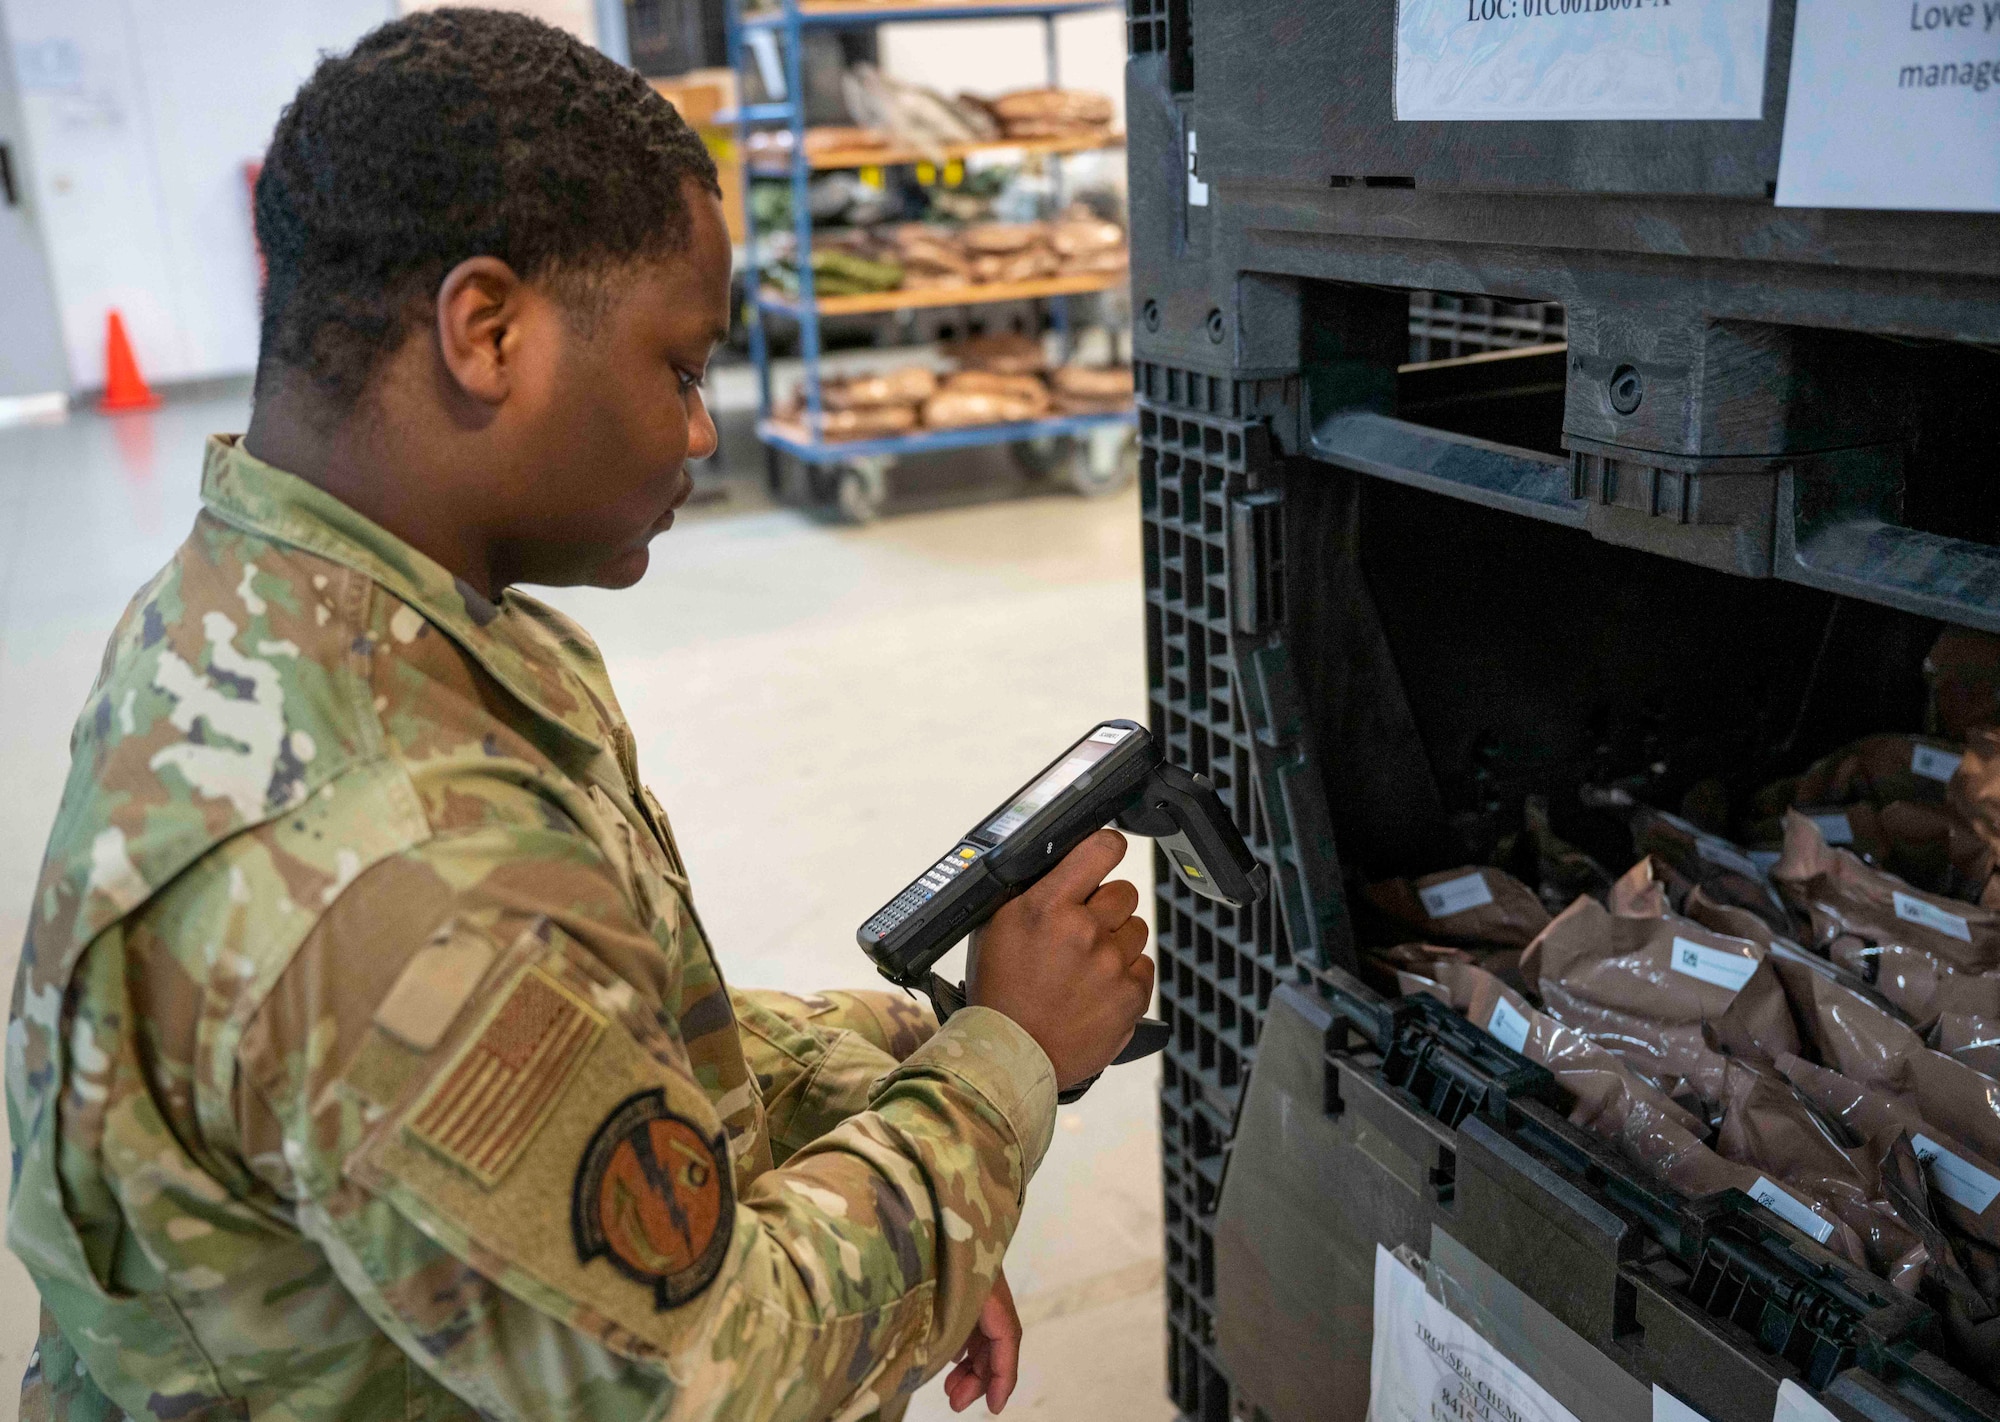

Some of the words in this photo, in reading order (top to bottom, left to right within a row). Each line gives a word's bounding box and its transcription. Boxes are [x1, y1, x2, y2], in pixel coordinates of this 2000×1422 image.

[1467, 0, 1516, 22] LOC:
[1523, 0, 1671, 17] 01C001-
[1910, 0, 1975, 30] Love
[1982, 1, 2000, 33] y
